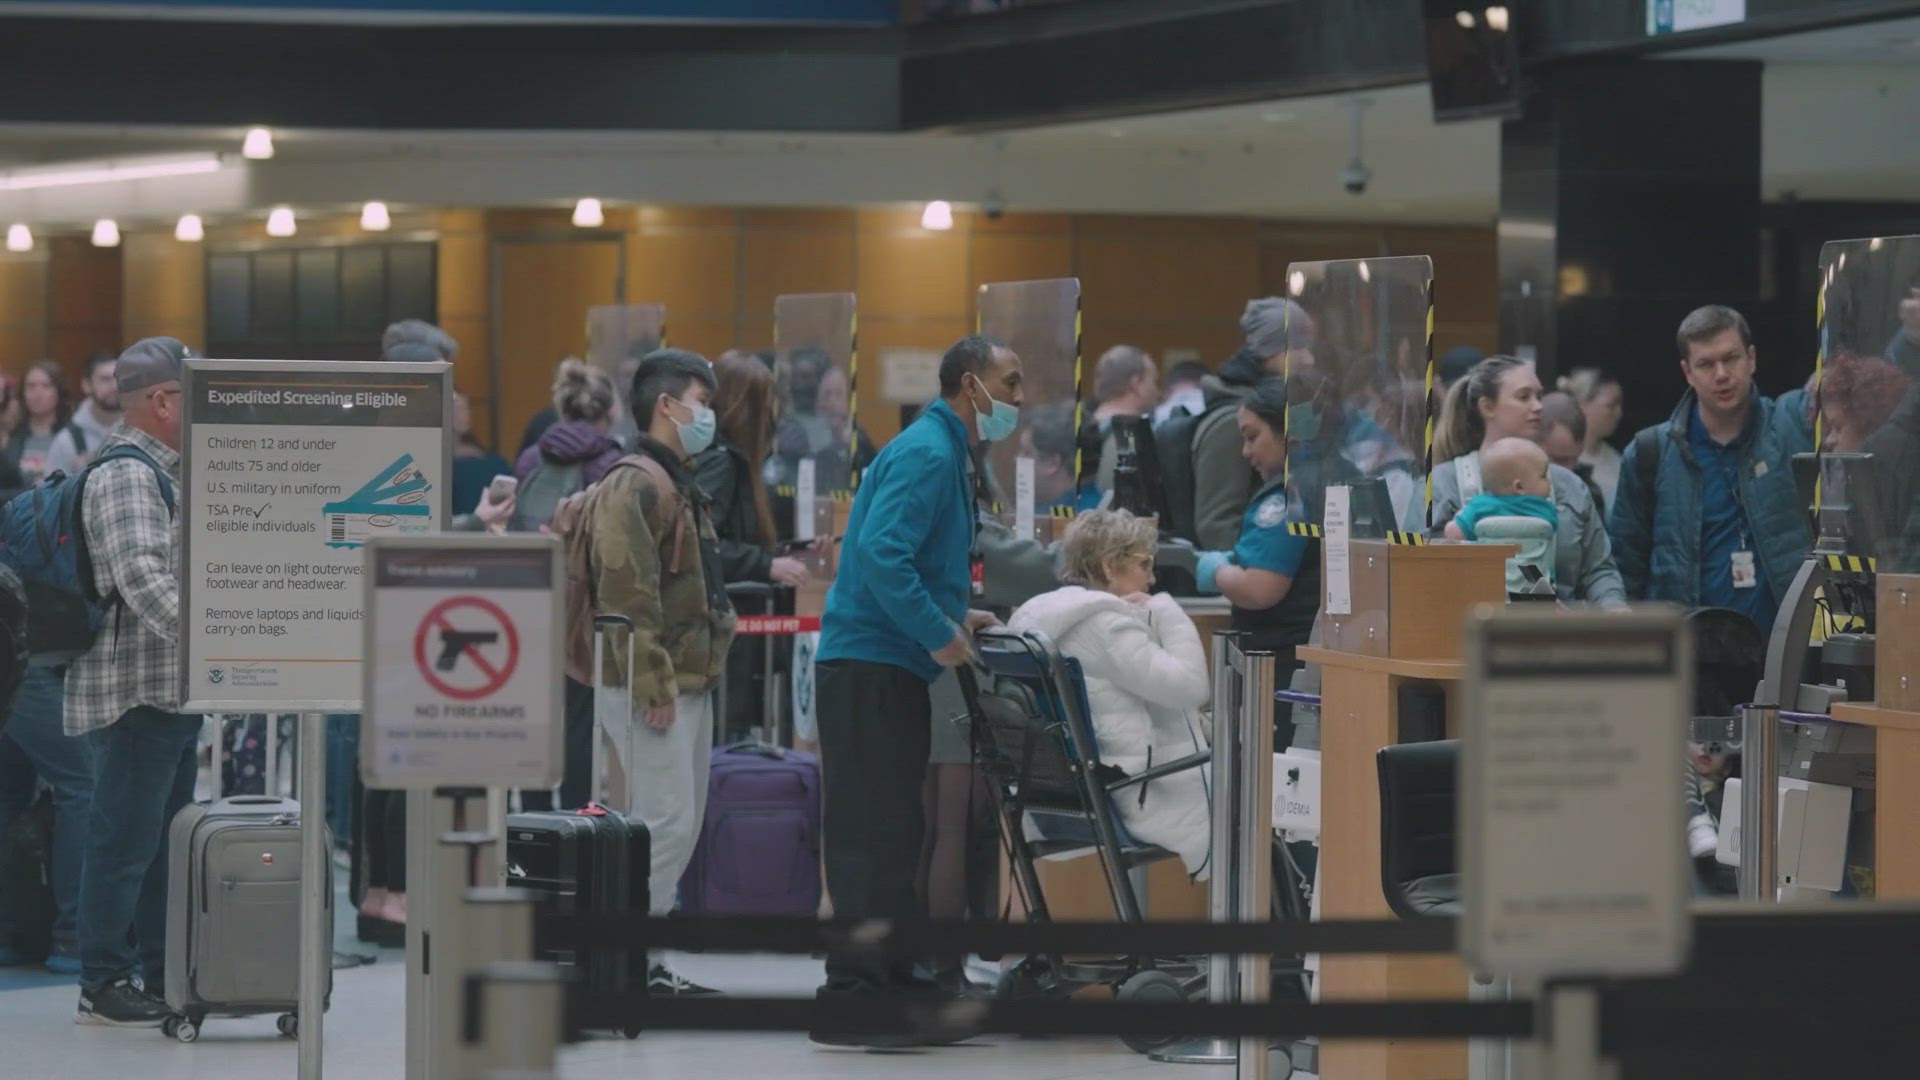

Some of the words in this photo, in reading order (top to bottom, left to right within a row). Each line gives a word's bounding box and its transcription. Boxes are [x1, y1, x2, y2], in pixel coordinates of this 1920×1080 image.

[208, 390, 281, 406] Expedited
[283, 391, 352, 407] Screening
[355, 393, 407, 408] Eligible
[207, 437, 257, 449] Children
[260, 438, 274, 449] 12
[277, 438, 300, 449] and
[302, 439, 337, 450] under
[207, 460, 245, 472] Adults
[248, 461, 263, 471] 75
[266, 461, 289, 472] and
[292, 461, 322, 472] older
[207, 483, 229, 494] U.S.
[231, 483, 277, 496] military
[280, 484, 293, 494] in
[295, 484, 341, 495] uniform
[207, 505, 229, 516] TSA
[206, 521, 249, 534] eligible
[252, 521, 316, 533] individuals
[206, 562, 228, 574] Can
[231, 563, 263, 574] leave
[266, 565, 281, 574] on
[284, 563, 310, 576] light
[312, 564, 366, 575] outerwea
[206, 578, 259, 590] footwear
[262, 578, 285, 589] and
[287, 578, 346, 590] headwear.
[206, 609, 254, 620] Remove
[257, 609, 299, 622] laptops
[302, 609, 324, 620] and
[327, 609, 365, 623] liquids
[205, 624, 255, 637] carry-on
[258, 624, 288, 637] bags.
[415, 704, 439, 719] NO
[443, 704, 527, 720] FIREARMS
